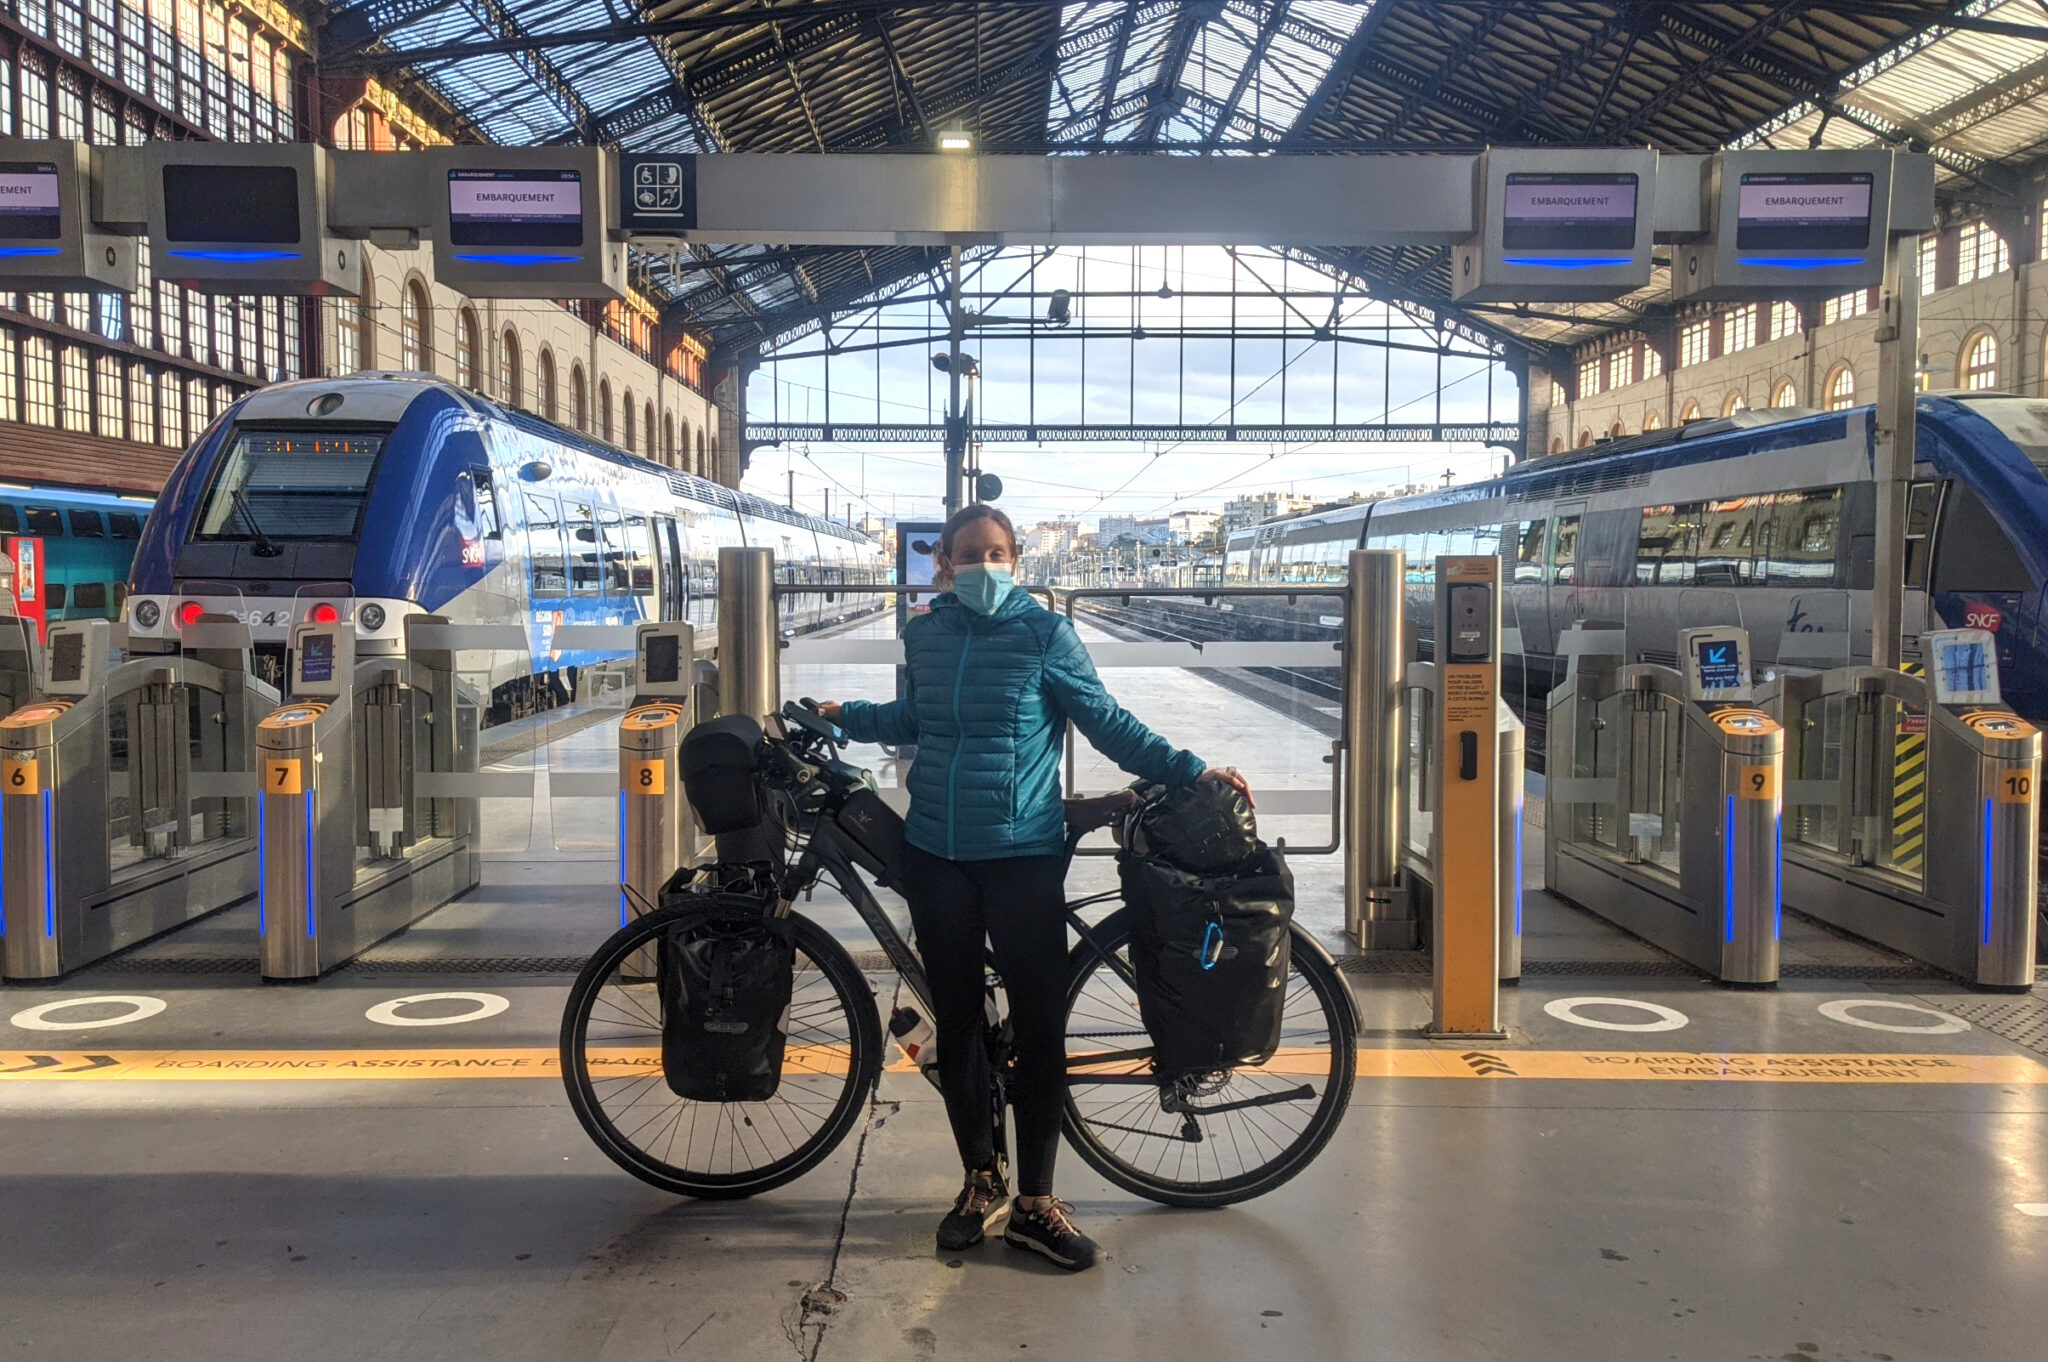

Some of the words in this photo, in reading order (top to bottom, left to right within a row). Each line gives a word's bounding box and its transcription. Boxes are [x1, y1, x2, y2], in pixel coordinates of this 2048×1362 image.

[476, 193, 555, 202] EMBARQUEMENT
[1531, 197, 1609, 206] EMBARQUEMENT
[1765, 197, 1844, 206] EMBARQUEMENT
[1965, 613, 2000, 628] SNCF
[11, 767, 26, 787] 6
[275, 767, 289, 786] 7
[640, 767, 653, 787] 8
[1752, 772, 1765, 791] 9
[2005, 776, 2030, 796] 10
[154, 1059, 328, 1068] BOARDING
[335, 1058, 533, 1068] ASSISTANCE
[1584, 1056, 1753, 1067] BOARDING
[1766, 1058, 1957, 1068] ASSISTANCE
[1649, 1066, 1920, 1078] EMBARQUEMENT
